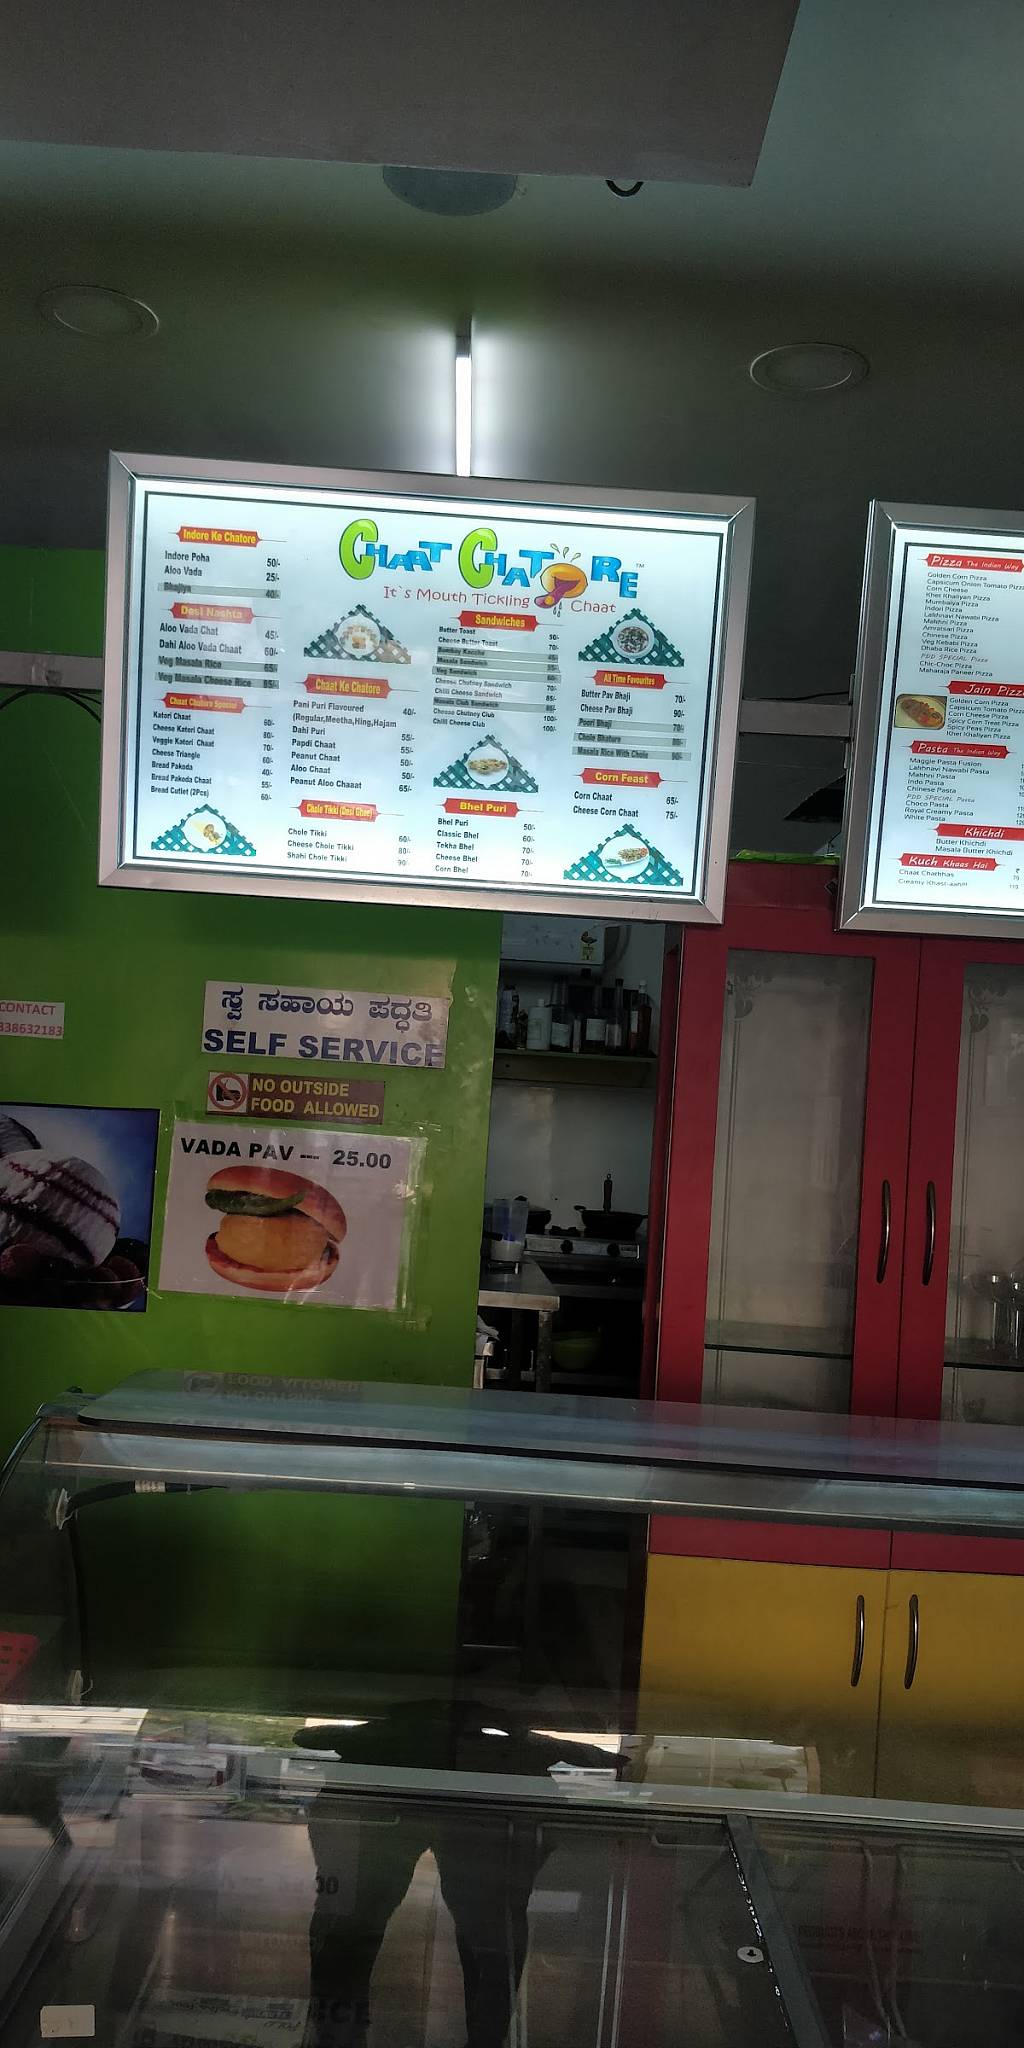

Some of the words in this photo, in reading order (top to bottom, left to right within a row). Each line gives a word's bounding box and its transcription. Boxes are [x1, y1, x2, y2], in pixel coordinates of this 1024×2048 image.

[183, 529, 208, 540] Indore
[211, 531, 222, 541] Ke
[224, 532, 256, 544] Chatore
[339, 519, 452, 580] CHAAT
[165, 551, 189, 561] Indore
[192, 553, 210, 562] Poha
[267, 558, 280, 567] 50/-
[931, 555, 962, 567] Pizza
[1005, 562, 1019, 571] Way
[164, 565, 181, 574] Aloo
[184, 567, 202, 576] Vada
[266, 573, 279, 581] 25/-
[417, 589, 467, 603] Mouth
[472, 593, 530, 608] Tickling
[571, 600, 616, 613] Chaat
[181, 605, 203, 616] Desi
[207, 607, 242, 618] Nashta
[476, 615, 525, 627] Sandwiches
[160, 623, 176, 632] Aloo
[180, 624, 198, 634] Vada
[201, 626, 218, 635] Chat
[160, 640, 176, 648] Dahi
[179, 641, 195, 650] Aloo
[198, 642, 217, 652] Vada
[220, 644, 242, 654] Chaat
[613, 675, 625, 683] Time
[316, 678, 337, 690] Chaat
[339, 681, 349, 691] Ke
[352, 682, 380, 694] Chatore
[965, 685, 991, 694] Jain
[581, 690, 600, 698] Butter
[602, 691, 613, 699] Pav
[615, 692, 630, 702] Bhaji
[294, 700, 309, 708] Pani
[312, 701, 326, 709] Puri
[328, 702, 364, 712] Flavoured
[581, 704, 602, 712] Cheese
[605, 705, 616, 713] Pav
[617, 707, 632, 716] Bhaji
[153, 712, 171, 720] Katori
[482, 709, 494, 717] Club
[153, 724, 175, 732] Cheese
[177, 725, 195, 733] Katori
[293, 726, 309, 734] Dahi
[311, 727, 325, 735] Puri
[153, 736, 172, 745] Veggie
[292, 739, 312, 748] Papdi
[918, 743, 948, 753] Pasta
[152, 749, 174, 757] Cheese
[176, 750, 200, 760] Triangle
[292, 752, 316, 760] Peanut
[319, 753, 340, 762] Chaat
[152, 761, 169, 769] Bread
[171, 762, 192, 771] Pakoda
[291, 764, 307, 772] Aloo
[309, 766, 330, 774] Chaat
[152, 774, 169, 782] Bread
[171, 775, 192, 783] Pakoda
[291, 777, 316, 785] Peanut
[318, 779, 334, 787] Aloo
[596, 772, 618, 781] Corn
[622, 774, 648, 784] Feast
[151, 786, 168, 794] Bread
[170, 787, 188, 795] Cutlet
[190, 788, 209, 798] (2Pcs)
[574, 791, 590, 800] Corn
[592, 792, 612, 801] Chaat
[460, 802, 482, 811] Bhel
[487, 804, 506, 812] Puri
[573, 806, 598, 814] Cheese
[600, 808, 616, 816] Corn
[618, 808, 638, 818] Chaat
[437, 830, 461, 838] Classic
[965, 828, 1005, 838] Khichdi
[288, 840, 312, 848] Cheese
[909, 856, 938, 865] Kuch
[258, 987, 354, 1017] ಸಹಾಯ
[203, 1029, 287, 1056] SELF
[298, 1035, 446, 1066] SERVICE
[252, 1078, 275, 1093] NO
[280, 1080, 349, 1097] OUTSIDE
[251, 1098, 294, 1113] FOOD
[303, 1103, 380, 1118] ALLOWED
[181, 1138, 241, 1157] VADA
[249, 1143, 294, 1161] PAV
[332, 1150, 392, 1169] 25.00
